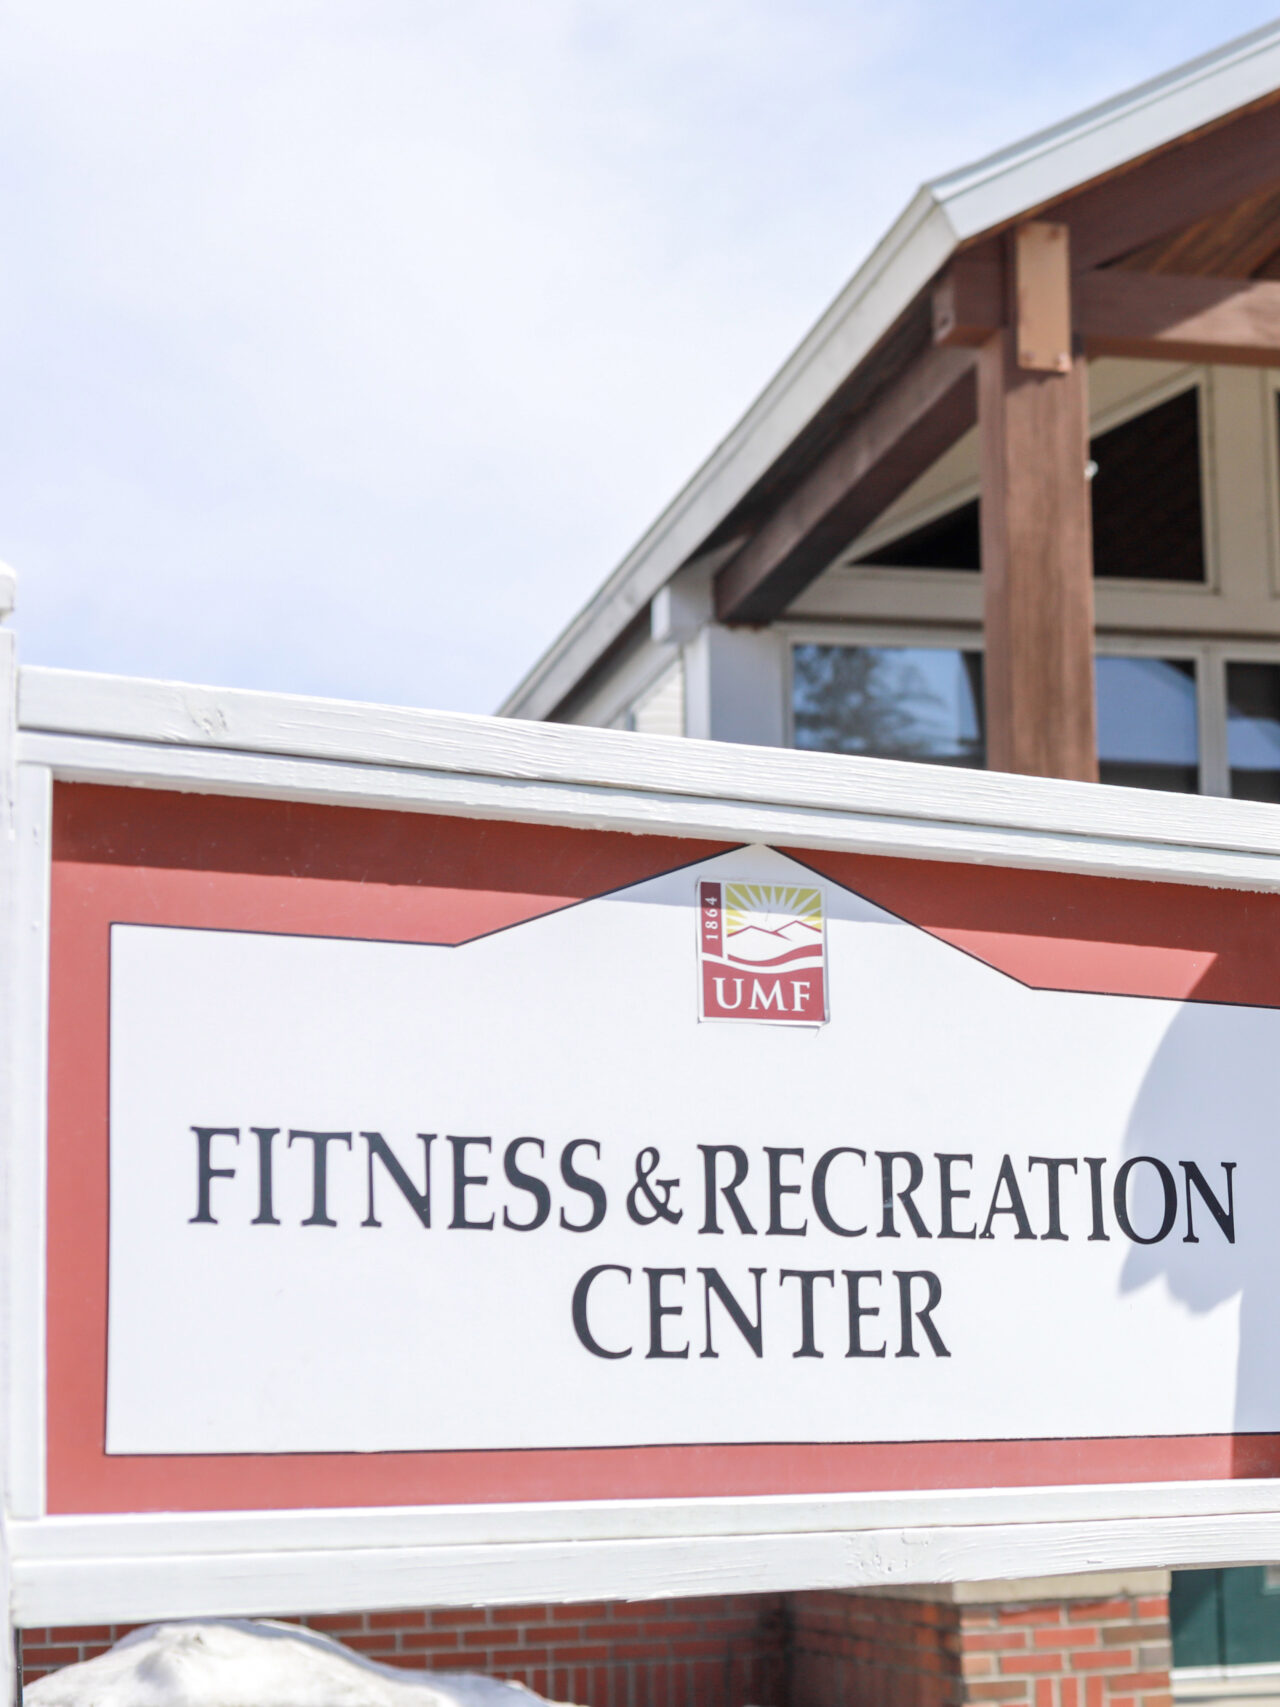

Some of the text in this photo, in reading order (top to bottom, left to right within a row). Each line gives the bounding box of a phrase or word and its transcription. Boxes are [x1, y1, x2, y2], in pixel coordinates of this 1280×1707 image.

[705, 897, 719, 940] 1864
[712, 977, 811, 1012] UMF
[188, 1126, 1237, 1245] FITNESS & RECREATION
[572, 1264, 951, 1359] CENTER
